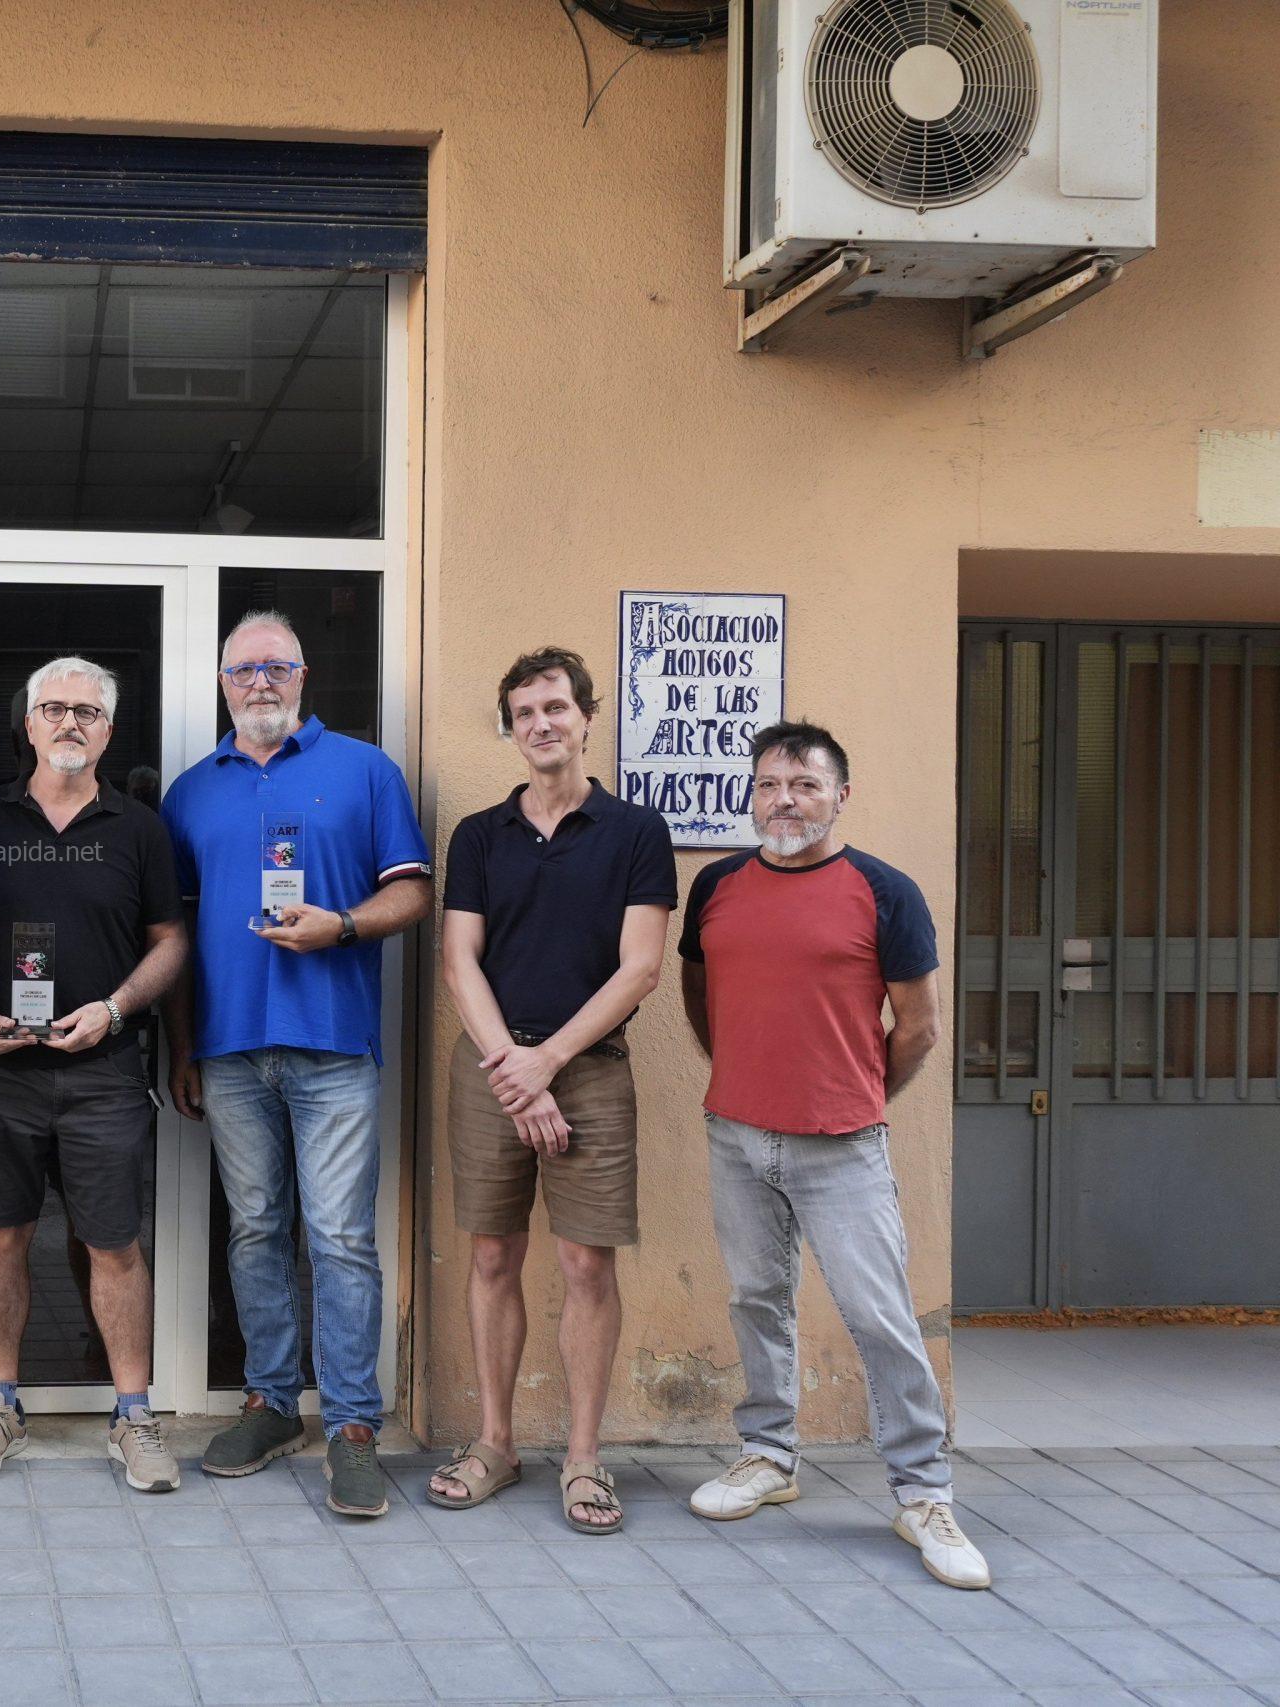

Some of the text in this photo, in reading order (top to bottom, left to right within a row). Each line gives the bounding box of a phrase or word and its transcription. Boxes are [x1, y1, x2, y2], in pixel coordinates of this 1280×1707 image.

[631, 602, 779, 649] ASOCIACION
[658, 649, 755, 678] AMIGOS
[665, 683, 760, 714] DE LAS
[641, 718, 760, 759] ARTES
